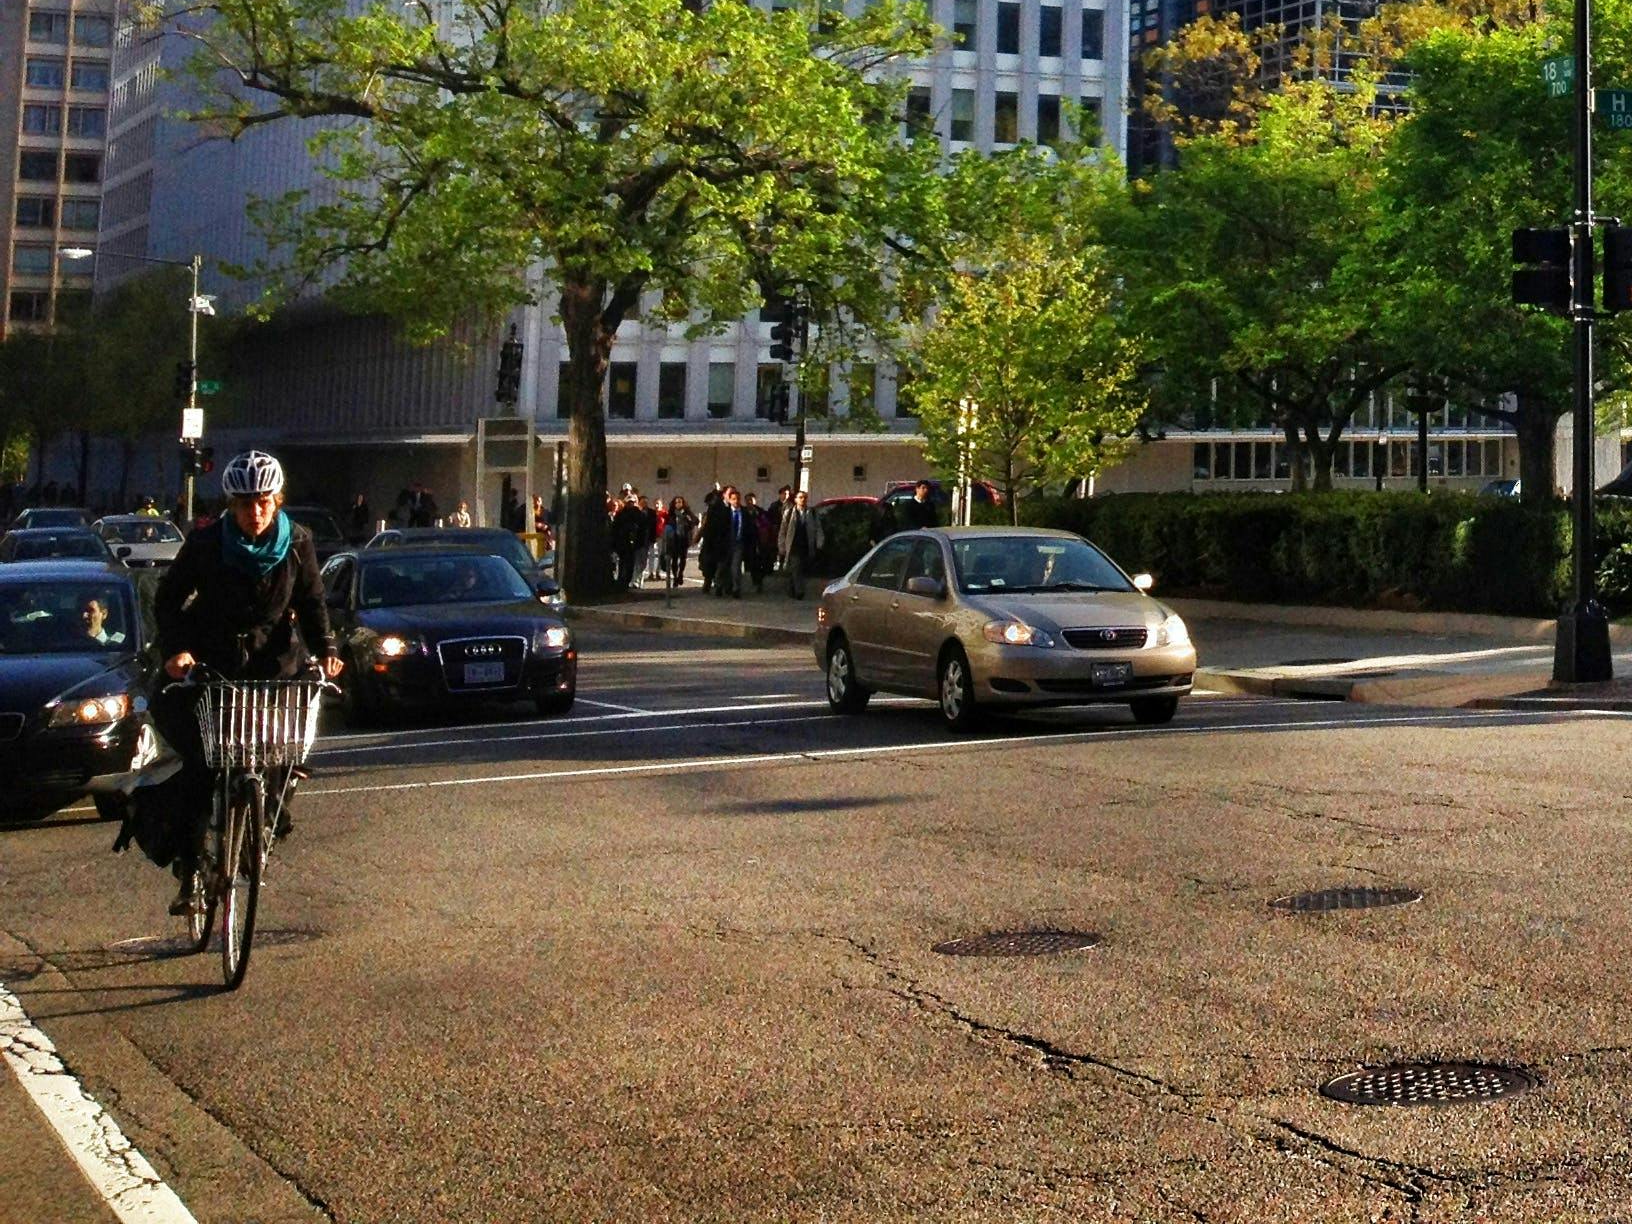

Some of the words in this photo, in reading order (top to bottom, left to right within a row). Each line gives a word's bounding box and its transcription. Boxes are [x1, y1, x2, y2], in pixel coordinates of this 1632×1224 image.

[1543, 61, 1557, 81] 18
[1552, 80, 1567, 96] 700
[1612, 93, 1626, 112] H
